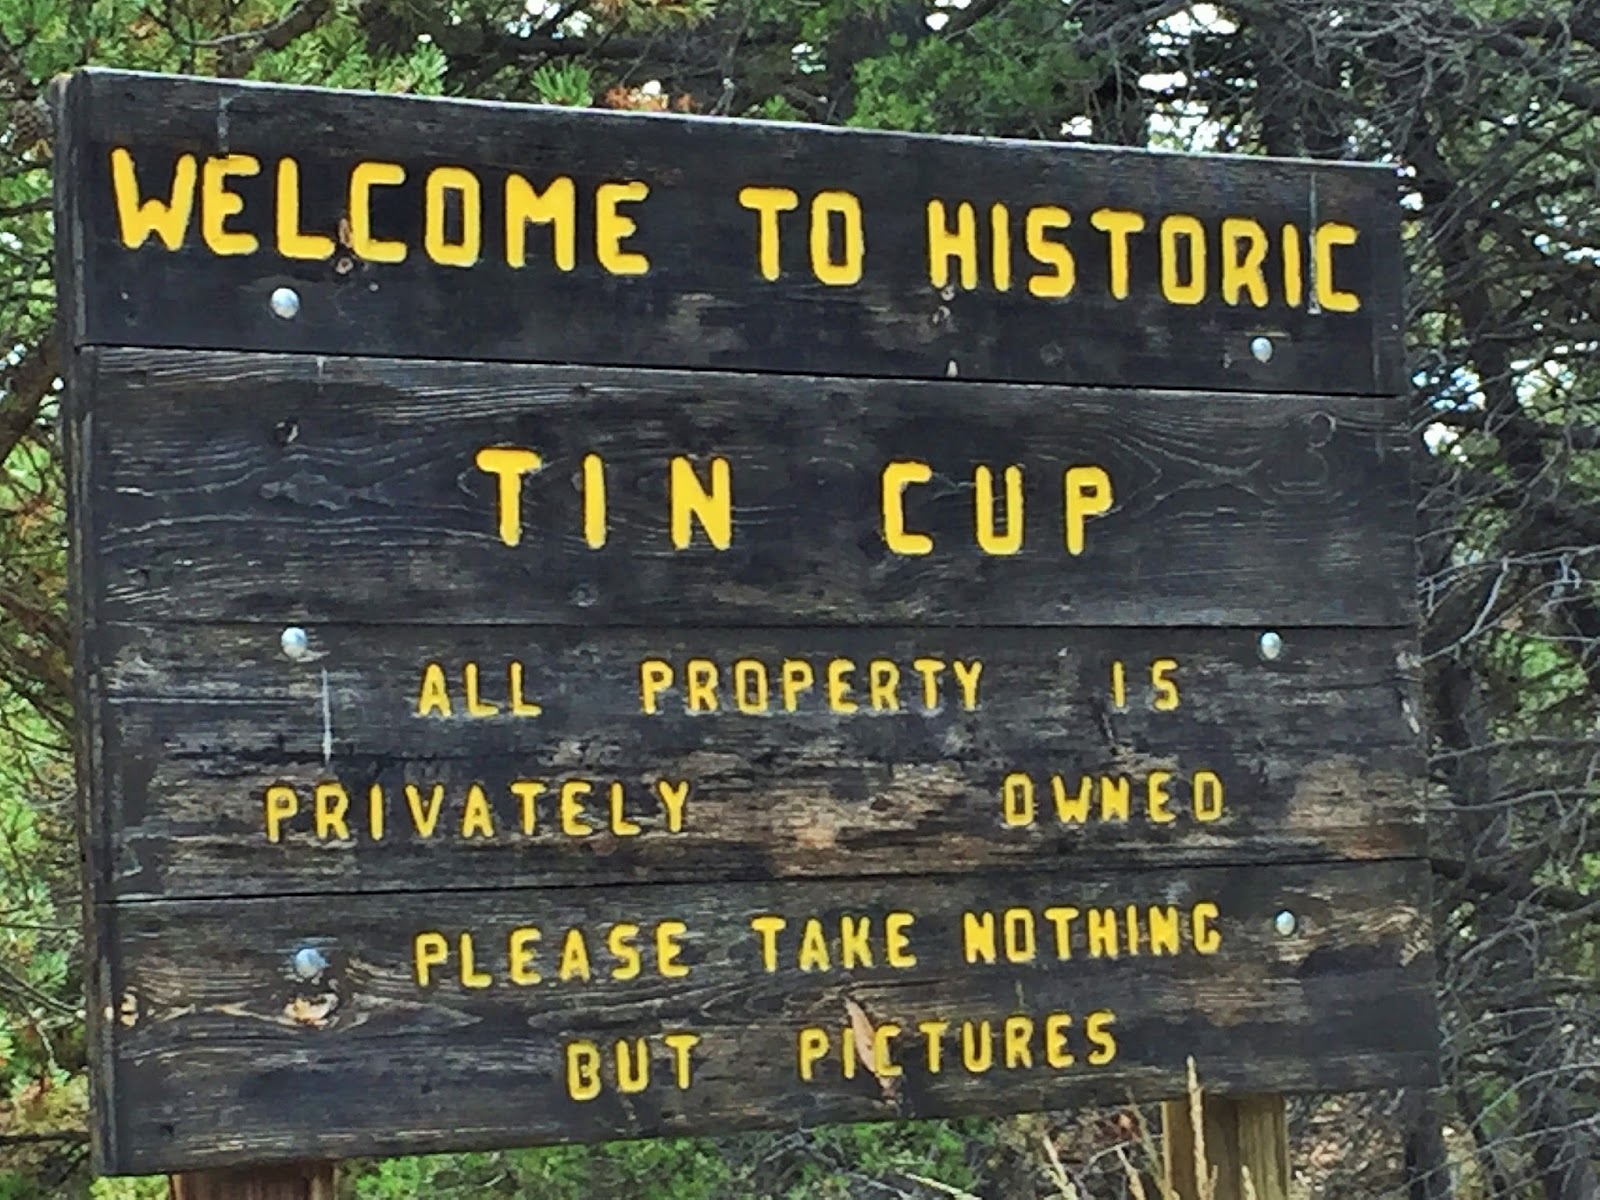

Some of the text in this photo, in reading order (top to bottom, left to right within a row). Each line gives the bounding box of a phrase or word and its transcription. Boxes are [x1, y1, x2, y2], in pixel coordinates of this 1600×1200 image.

[111, 147, 1361, 312] WELCOME TO HISTORIC
[476, 449, 1114, 555] TIN CUP
[419, 659, 1179, 717] ALL PROPERTY IS
[265, 772, 1224, 843] PRIVATELY OWNED
[415, 903, 1221, 988] PLEASE TAKE NOTHING
[567, 1010, 1117, 1101] BUT PICTURES
